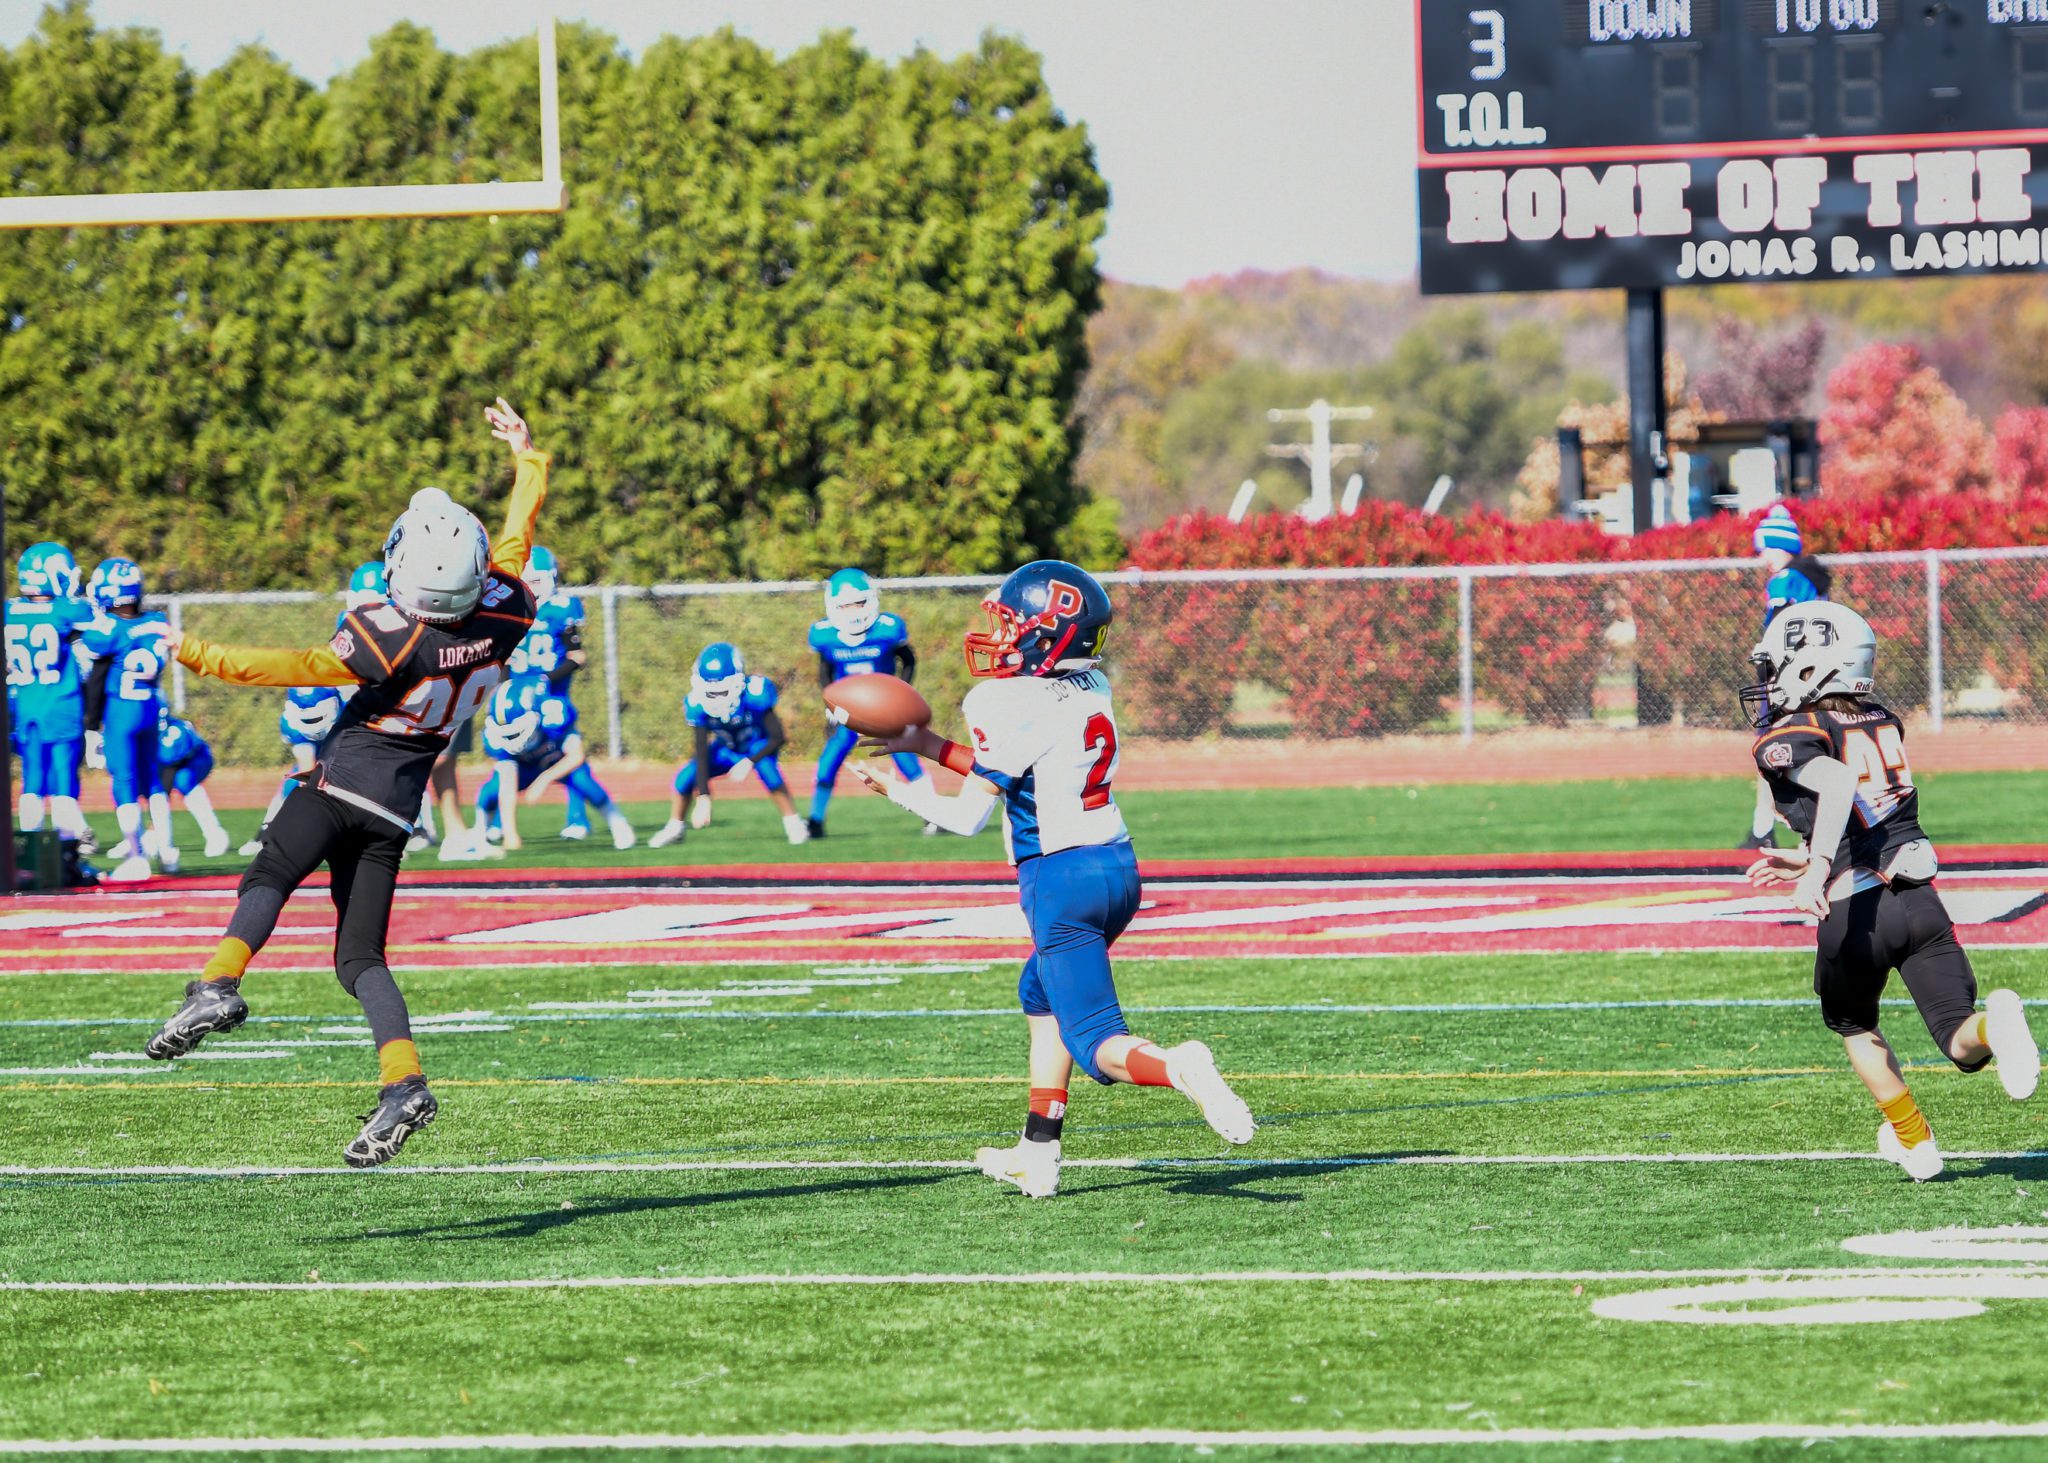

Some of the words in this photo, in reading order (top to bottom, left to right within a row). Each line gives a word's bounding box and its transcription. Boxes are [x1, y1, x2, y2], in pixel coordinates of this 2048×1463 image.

[1468, 9, 1507, 81] 3
[1436, 91, 1547, 147] T.O.L.
[1445, 162, 1692, 244] HOME
[1716, 156, 1828, 233] OF
[1852, 147, 2032, 227] THE
[1676, 237, 1818, 279] JONAS
[1831, 235, 1876, 273] R.
[1890, 227, 2048, 271] LASHM
[1041, 579, 1083, 630] P
[4, 623, 60, 686] 52
[1784, 617, 1834, 651] 23
[120, 648, 158, 700] 2
[1080, 711, 1116, 811] 2
